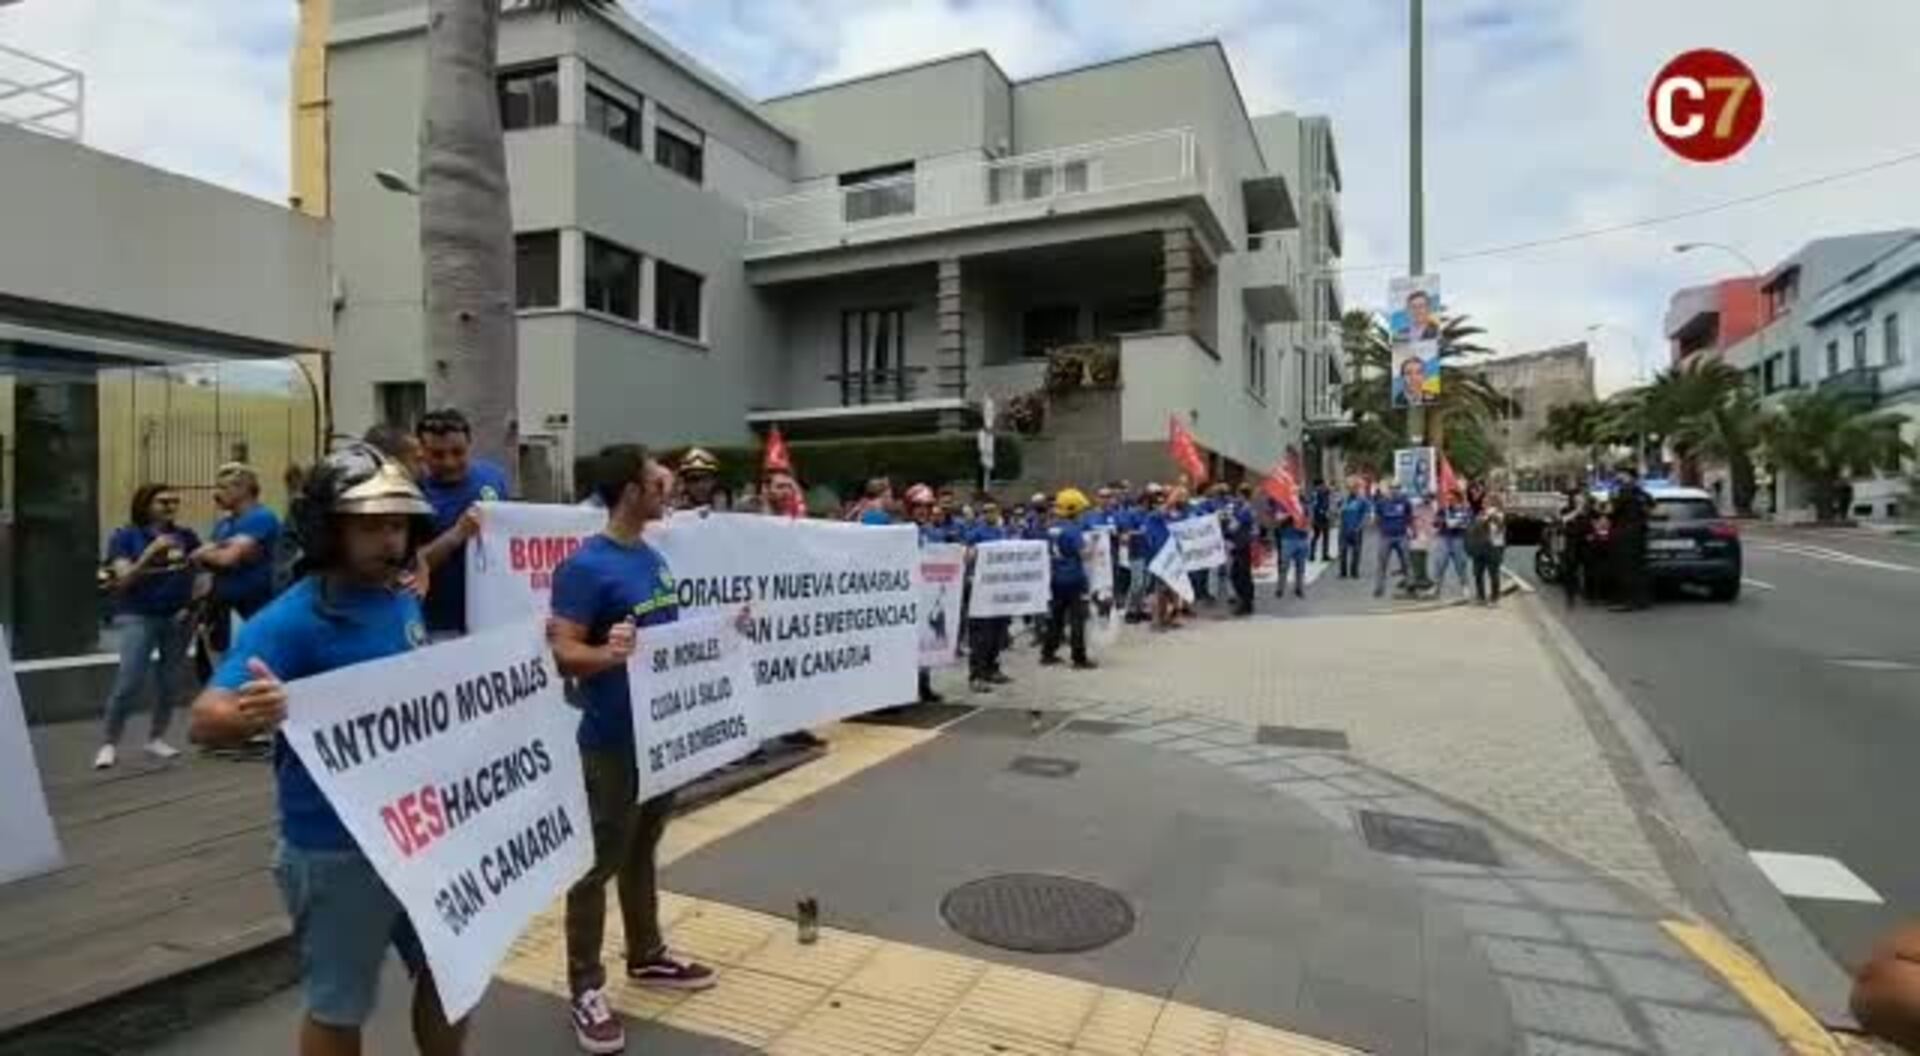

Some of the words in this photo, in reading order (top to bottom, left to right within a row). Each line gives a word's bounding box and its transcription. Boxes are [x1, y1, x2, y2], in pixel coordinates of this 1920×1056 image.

[673, 574, 750, 607] ORALES
[757, 575, 769, 601] Y
[773, 572, 834, 600] NUEVA
[838, 569, 911, 595] CANARIAS
[777, 613, 810, 640] LAS
[815, 603, 917, 637] EMERGENCIAS
[753, 656, 796, 686] RAN
[801, 645, 871, 678] CANARIA
[312, 689, 449, 774] ANTONIO
[455, 656, 548, 722] MORALES
[380, 739, 552, 857] DESHACEMOS
[479, 805, 574, 895] CANARIA
